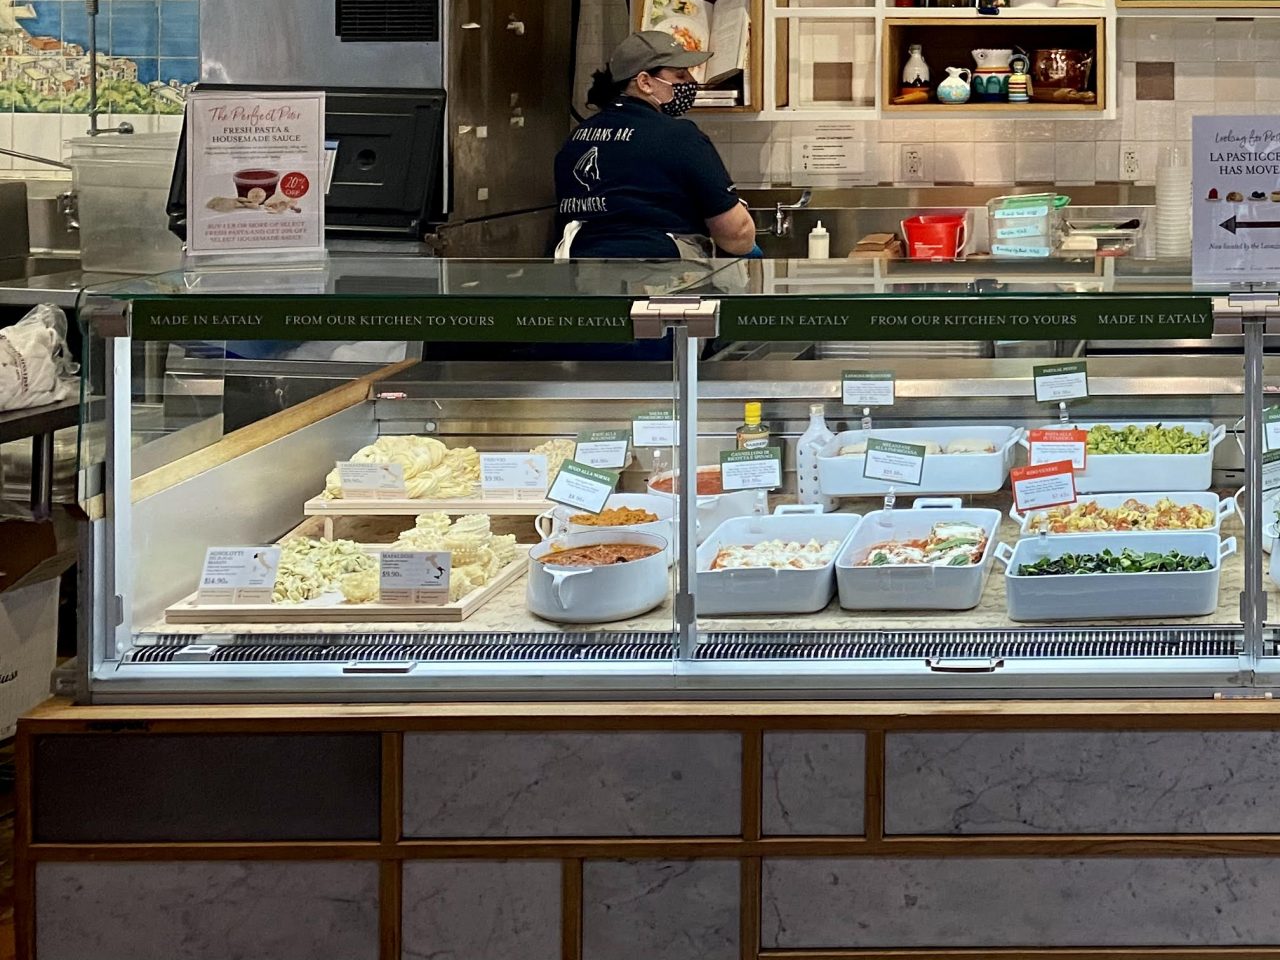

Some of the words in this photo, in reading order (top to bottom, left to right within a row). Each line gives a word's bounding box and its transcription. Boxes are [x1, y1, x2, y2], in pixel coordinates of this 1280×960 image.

[208, 105, 229, 122] The
[231, 105, 275, 126] Perfect
[223, 126, 252, 134] FRESH
[254, 126, 282, 134] PASTA
[283, 126, 290, 134] &
[572, 127, 613, 141] ITALIANS
[614, 127, 635, 141] ARE
[212, 135, 271, 143] HOUSEMADE
[1215, 129, 1247, 148] Looking
[1247, 129, 1262, 147] for
[1210, 152, 1225, 162] LA
[1219, 165, 1243, 175] HAS
[560, 196, 608, 213] EVERYWHERE
[150, 315, 188, 325] MADE
[193, 315, 208, 325] IN
[212, 315, 262, 325] EATALY
[285, 315, 322, 325] FROM
[326, 315, 356, 325] OUR
[360, 315, 422, 326] KITCHEN
[425, 315, 446, 326] TO
[449, 315, 495, 326] YOURS
[516, 316, 555, 326] MADE
[558, 316, 574, 326] IN
[577, 316, 627, 327] EATALY
[737, 315, 776, 326] MADE
[780, 315, 794, 326] IN
[799, 315, 849, 326] EATALY
[870, 315, 907, 326] FROM
[911, 315, 940, 326] OUR
[944, 315, 1006, 325] KITCHEN
[1009, 315, 1030, 325] TO
[1032, 314, 1077, 325] YOURS
[1098, 314, 1136, 325] MADE
[1140, 314, 1154, 324] IN
[1158, 313, 1208, 324] EATALY
